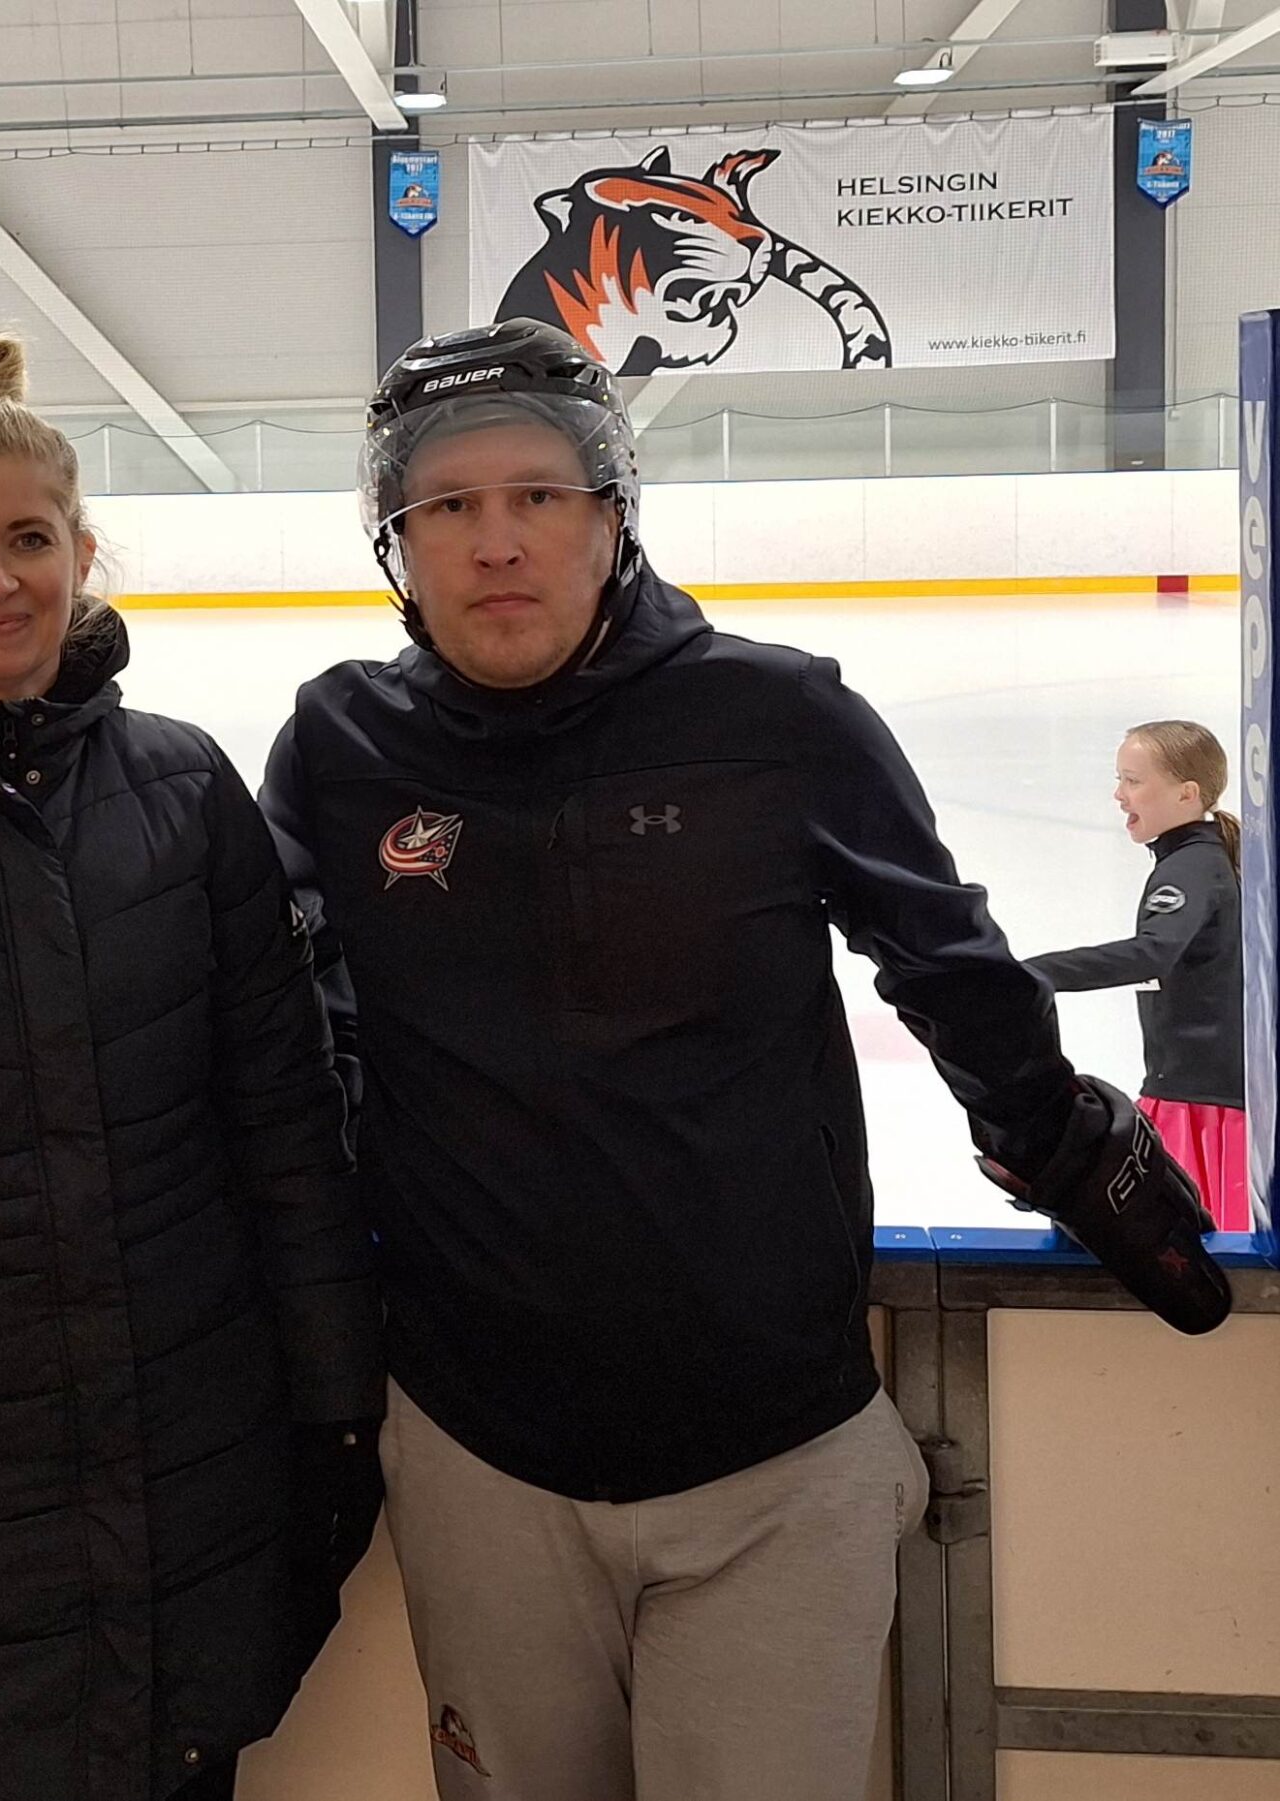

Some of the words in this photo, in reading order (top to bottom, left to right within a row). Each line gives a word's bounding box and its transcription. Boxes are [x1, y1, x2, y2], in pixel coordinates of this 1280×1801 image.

[836, 172, 998, 197] HELSINGIN
[836, 198, 1074, 227] KIEKKO-TIIKERIT
[927, 330, 1087, 351] www.kiekko-tiikerit.fi
